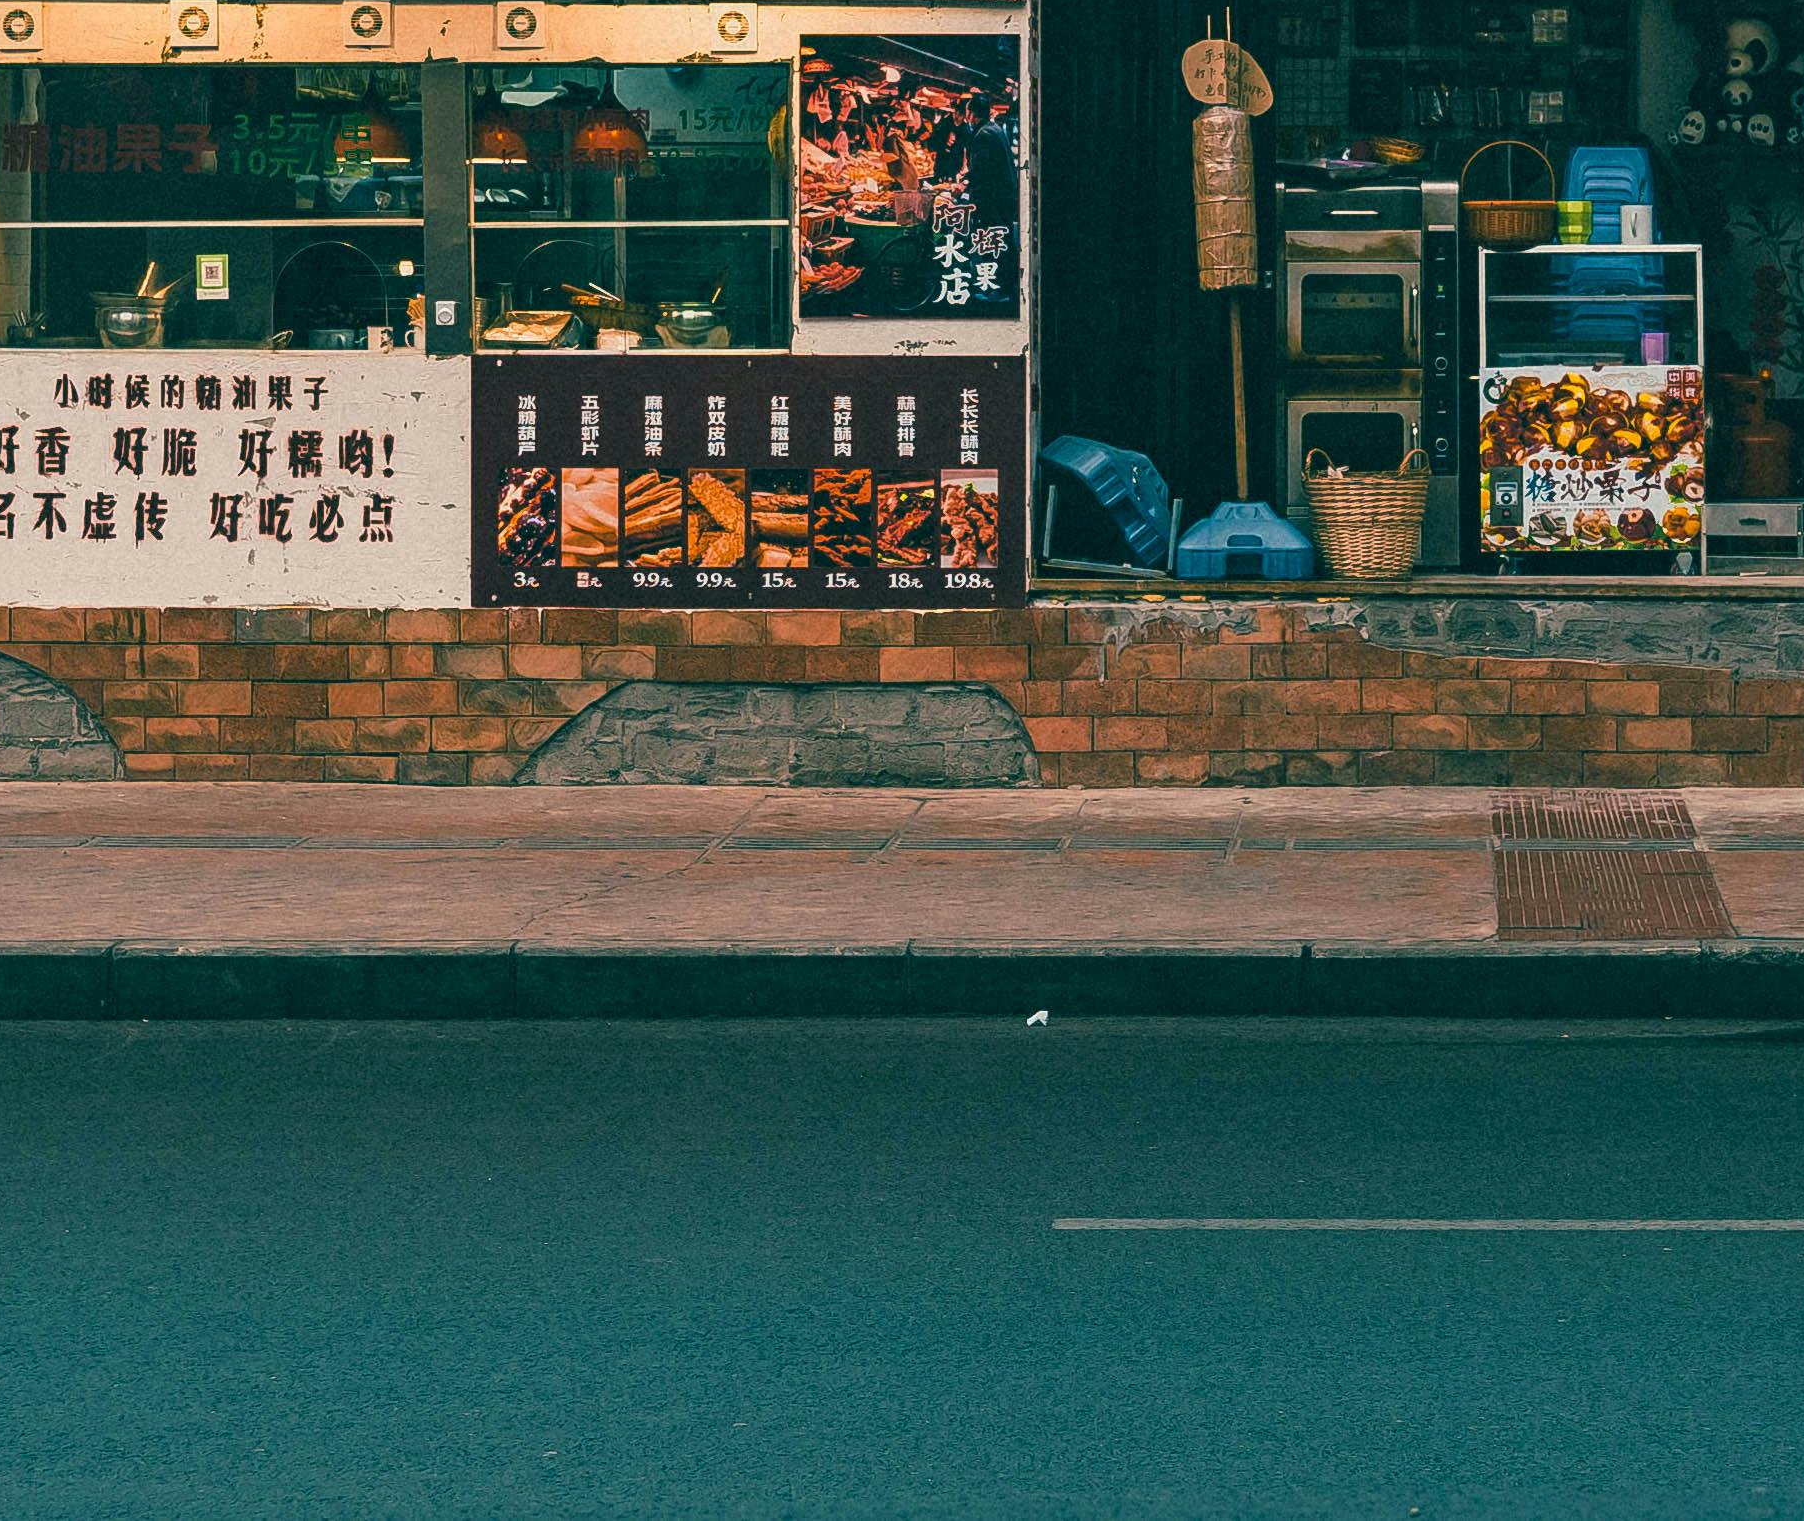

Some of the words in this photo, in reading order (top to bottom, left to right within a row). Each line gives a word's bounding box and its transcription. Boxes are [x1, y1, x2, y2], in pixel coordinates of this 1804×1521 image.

[54, 374, 329, 411] 小时候的糖油果子
[518, 395, 537, 457] 冰糖葫芦
[708, 396, 727, 457] 炸双皮奶
[833, 396, 852, 457] 美好酥肉
[897, 396, 916, 458] 蒜香排骨
[960, 388, 979, 465] 长长长酥肉
[112, 425, 197, 478] 好脆
[1525, 470, 1661, 503] 糖炒栗子
[208, 492, 395, 544] 好吃必点
[513, 572, 540, 588] 3元
[632, 572, 674, 588] 9.9元
[695, 572, 737, 588] 9.9元
[762, 572, 797, 588] 15元
[824, 572, 860, 588] 15元
[888, 572, 924, 588] 18元
[944, 572, 995, 588] 19.8元
